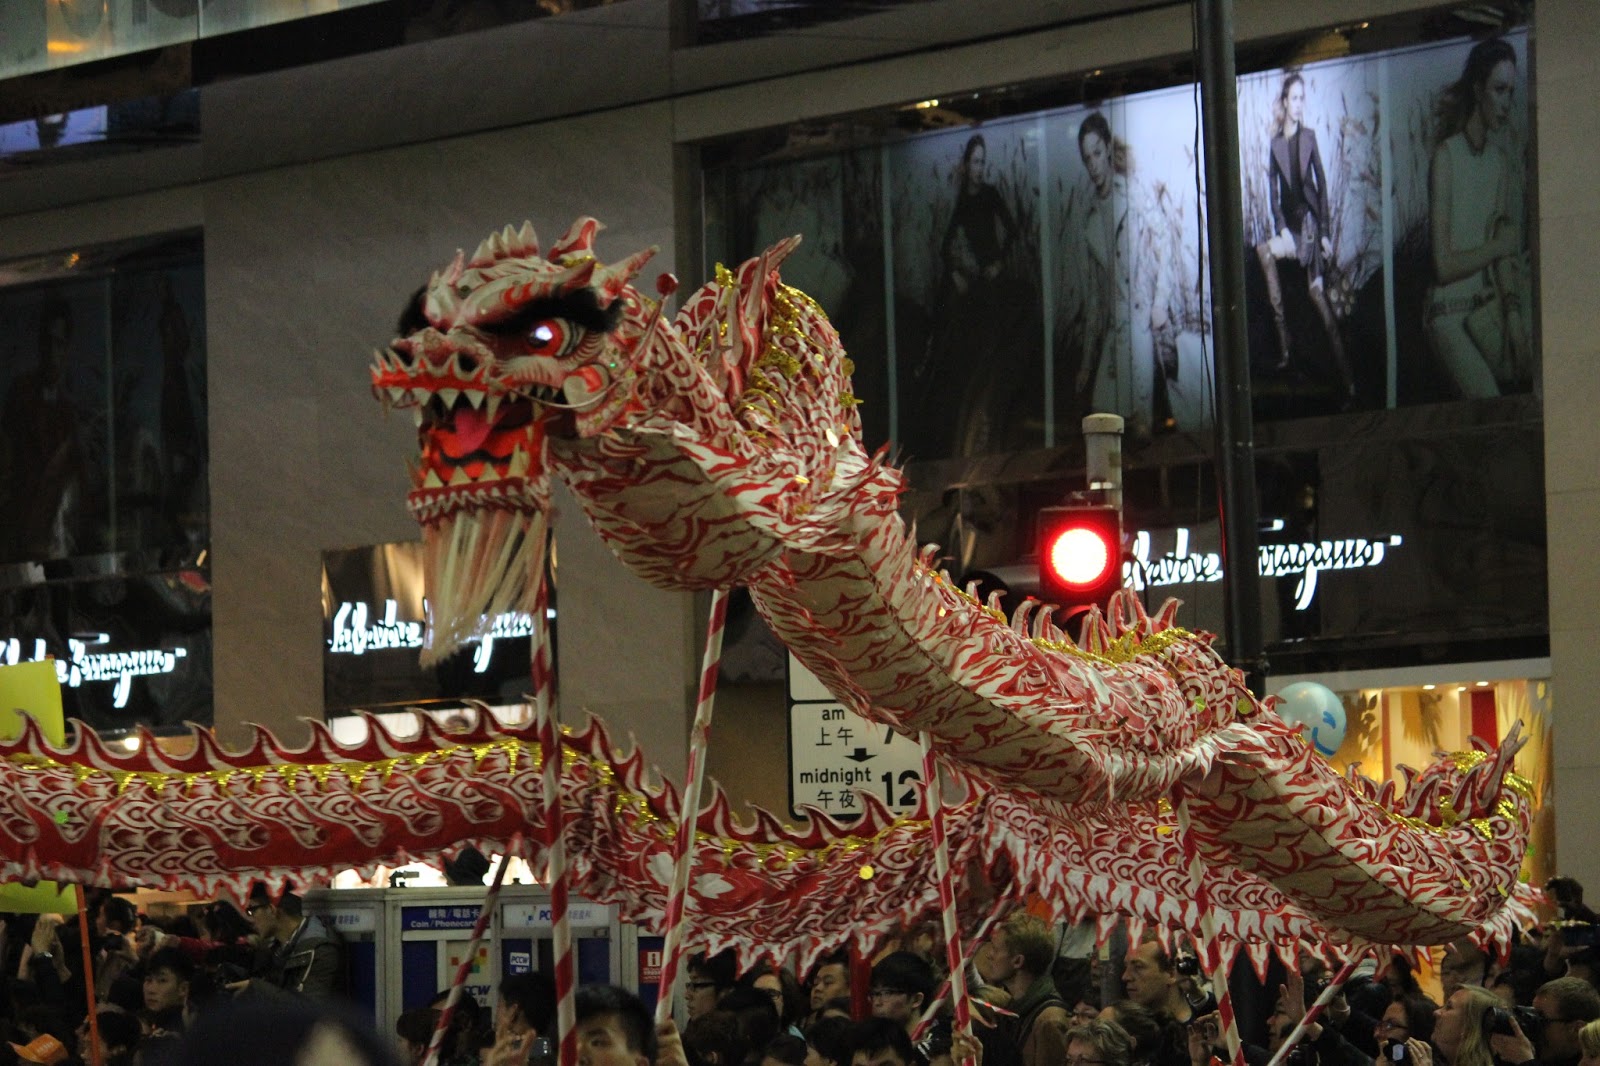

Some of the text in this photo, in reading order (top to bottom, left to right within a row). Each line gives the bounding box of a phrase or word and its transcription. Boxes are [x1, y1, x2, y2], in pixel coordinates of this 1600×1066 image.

[822, 709, 845, 720] am
[815, 727, 854, 746] 上午
[800, 767, 920, 807] midnight 12
[817, 789, 855, 809] 午夜
[410, 920, 429, 928] Coin
